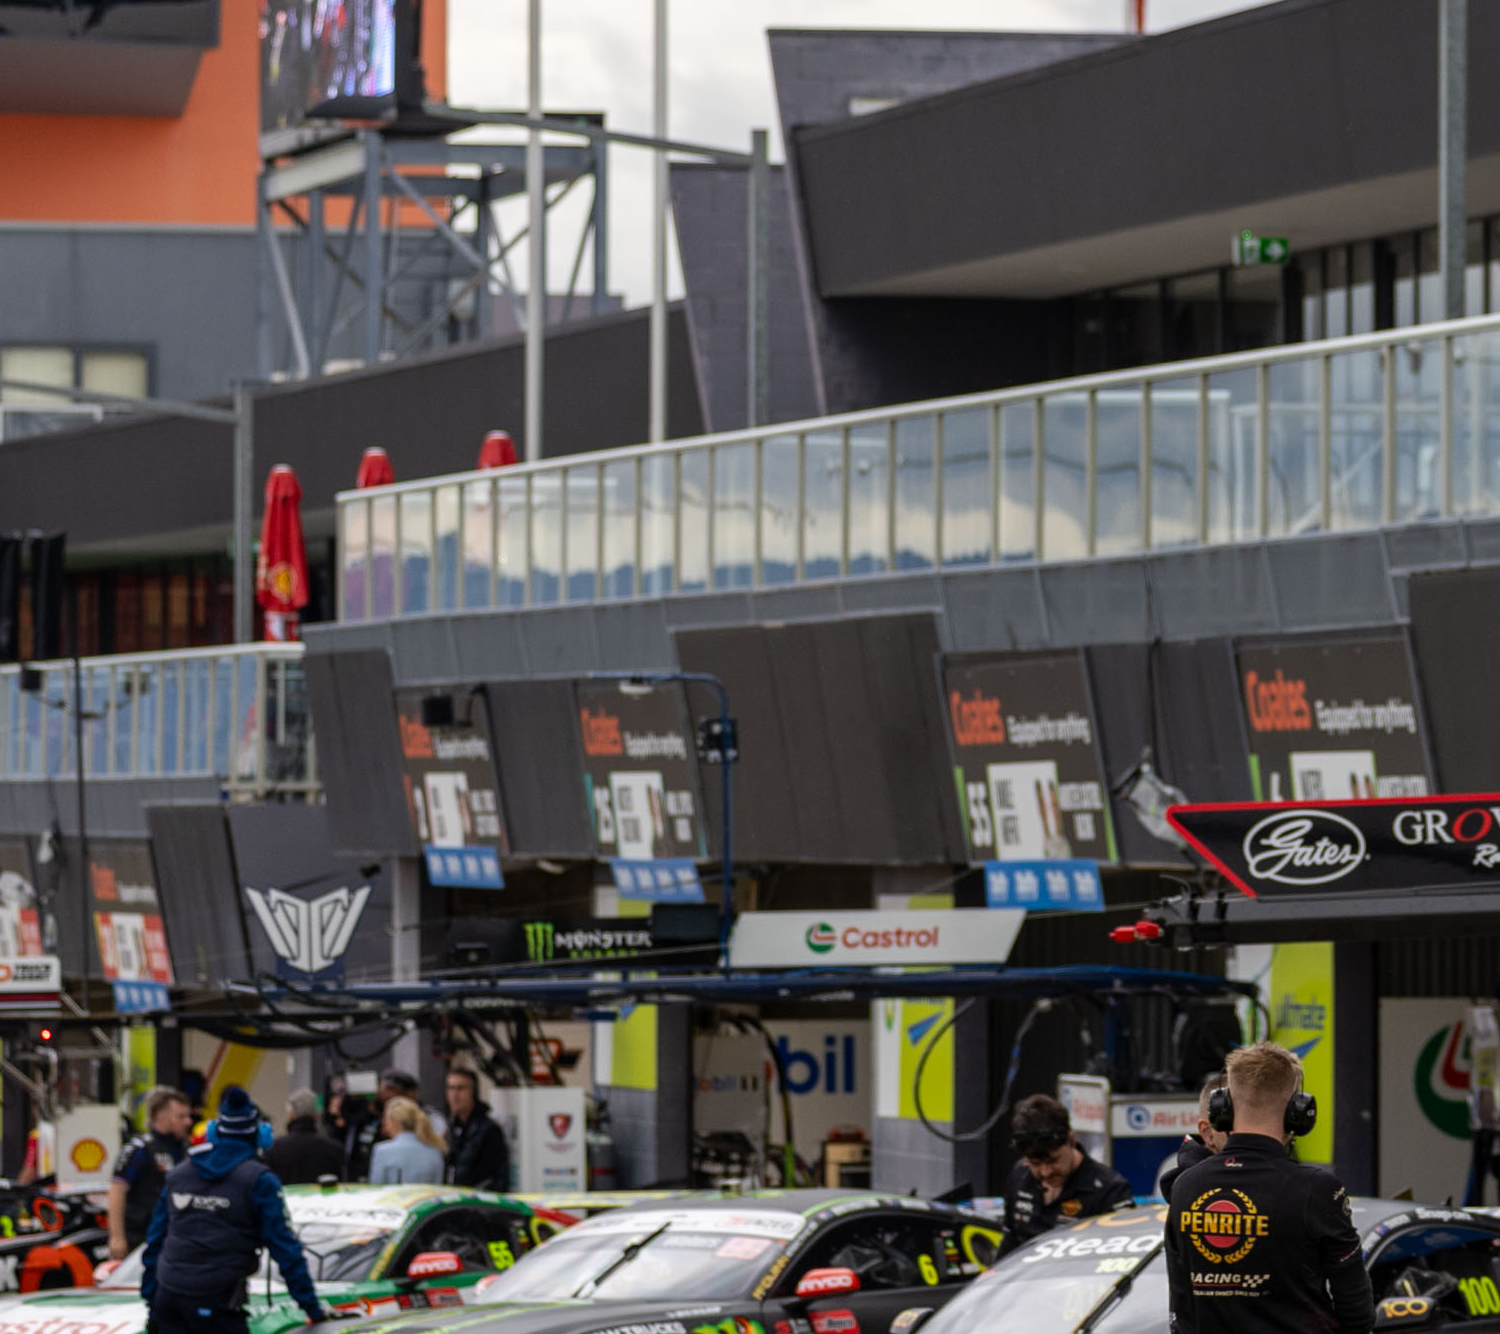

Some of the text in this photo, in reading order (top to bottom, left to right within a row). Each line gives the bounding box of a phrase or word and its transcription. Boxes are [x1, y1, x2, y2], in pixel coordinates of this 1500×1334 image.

[1248, 819, 1362, 879] Gates
[842, 926, 939, 950] Castrol
[1180, 1211, 1269, 1239] PENRITE
[917, 1253, 939, 1286] 6
